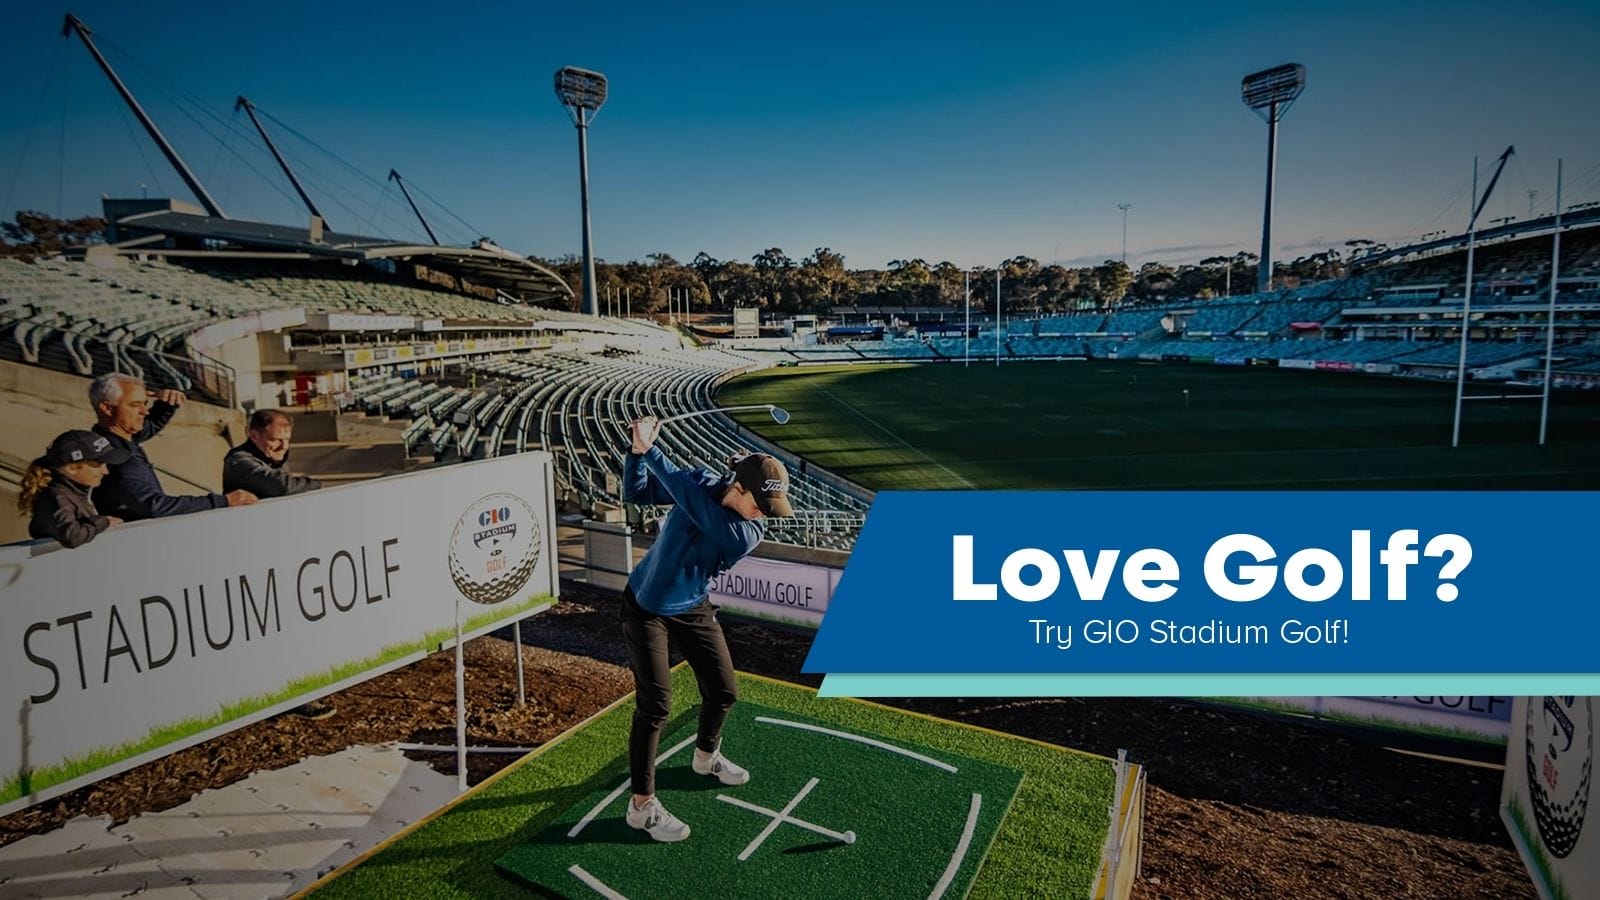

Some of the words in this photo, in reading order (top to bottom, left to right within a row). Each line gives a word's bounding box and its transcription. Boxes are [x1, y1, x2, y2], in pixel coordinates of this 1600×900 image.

[479, 507, 510, 526] GIO
[474, 524, 516, 541] STADIUM
[486, 556, 507, 574] GOLF
[711, 572, 771, 601] STADIUM
[775, 582, 813, 608] GOLF
[23, 568, 282, 704] STADIUM
[296, 538, 400, 622] GOLF
